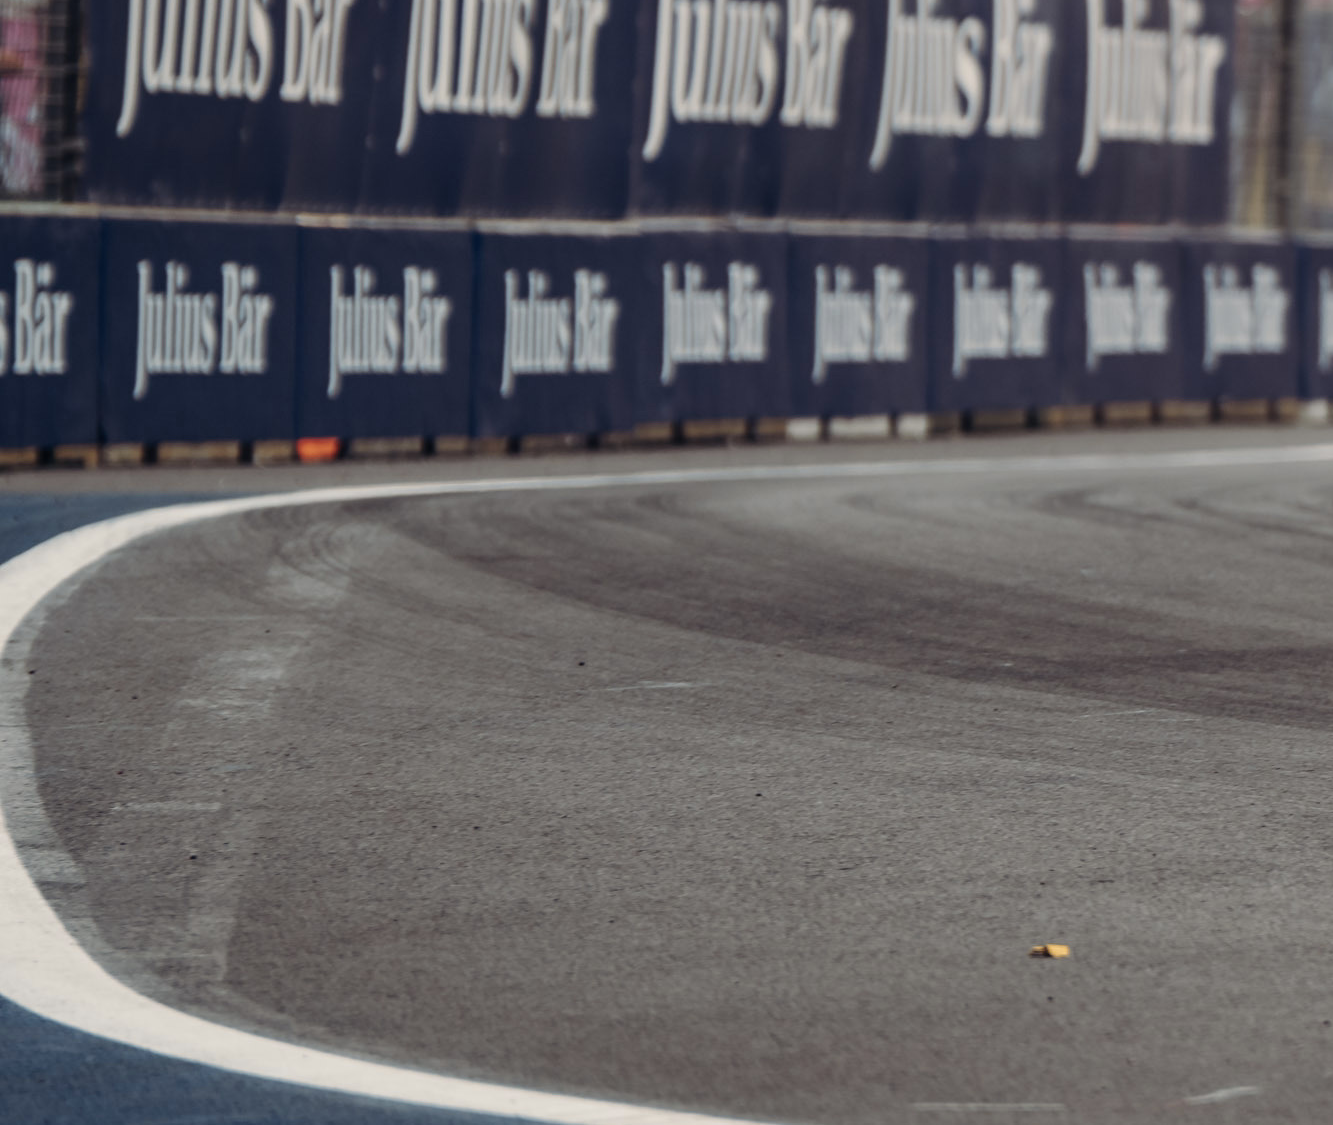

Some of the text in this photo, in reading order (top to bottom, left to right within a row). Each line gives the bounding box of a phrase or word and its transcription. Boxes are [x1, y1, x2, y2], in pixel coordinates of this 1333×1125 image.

[13, 259, 72, 374] Bär
[133, 260, 217, 399] Julius
[220, 262, 273, 373] Bär
[327, 264, 451, 398] Julius Bär
[501, 269, 619, 398] Julius Bär
[661, 261, 726, 385] Julius
[813, 264, 872, 384] Julius
